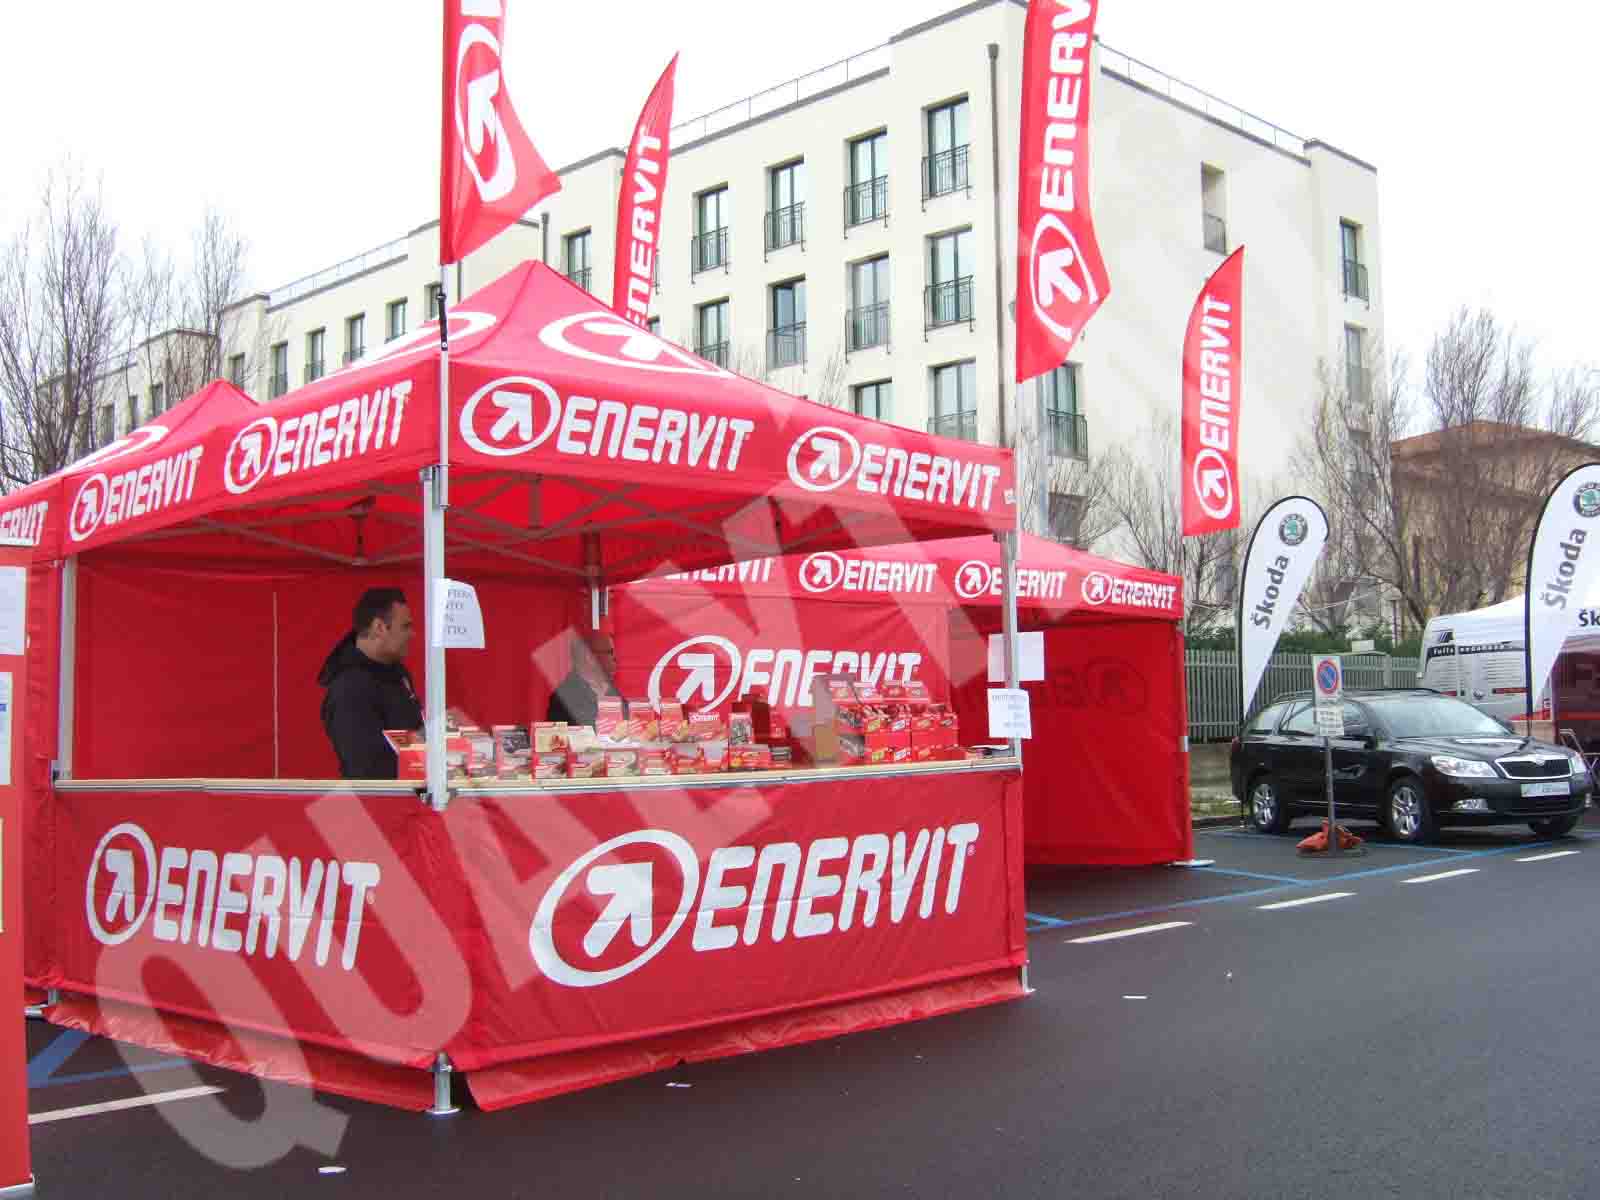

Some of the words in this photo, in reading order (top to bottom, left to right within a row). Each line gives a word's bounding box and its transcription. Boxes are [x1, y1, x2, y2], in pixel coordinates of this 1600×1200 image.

[1200, 294, 1232, 451] ENERVIT
[272, 379, 413, 477] ENERVIT
[556, 395, 754, 471] ENERVIT
[104, 445, 204, 525] ENERVIT
[856, 442, 1000, 511] ENERVIT
[843, 559, 938, 593] ENERVIT
[990, 567, 1068, 600] EERVIT
[1112, 577, 1177, 609] ENERVIT
[1250, 556, 1288, 630] Škoda
[1540, 528, 1587, 611] Škoda
[153, 847, 381, 971] ENERVIT
[690, 823, 980, 952] ENERVIT
